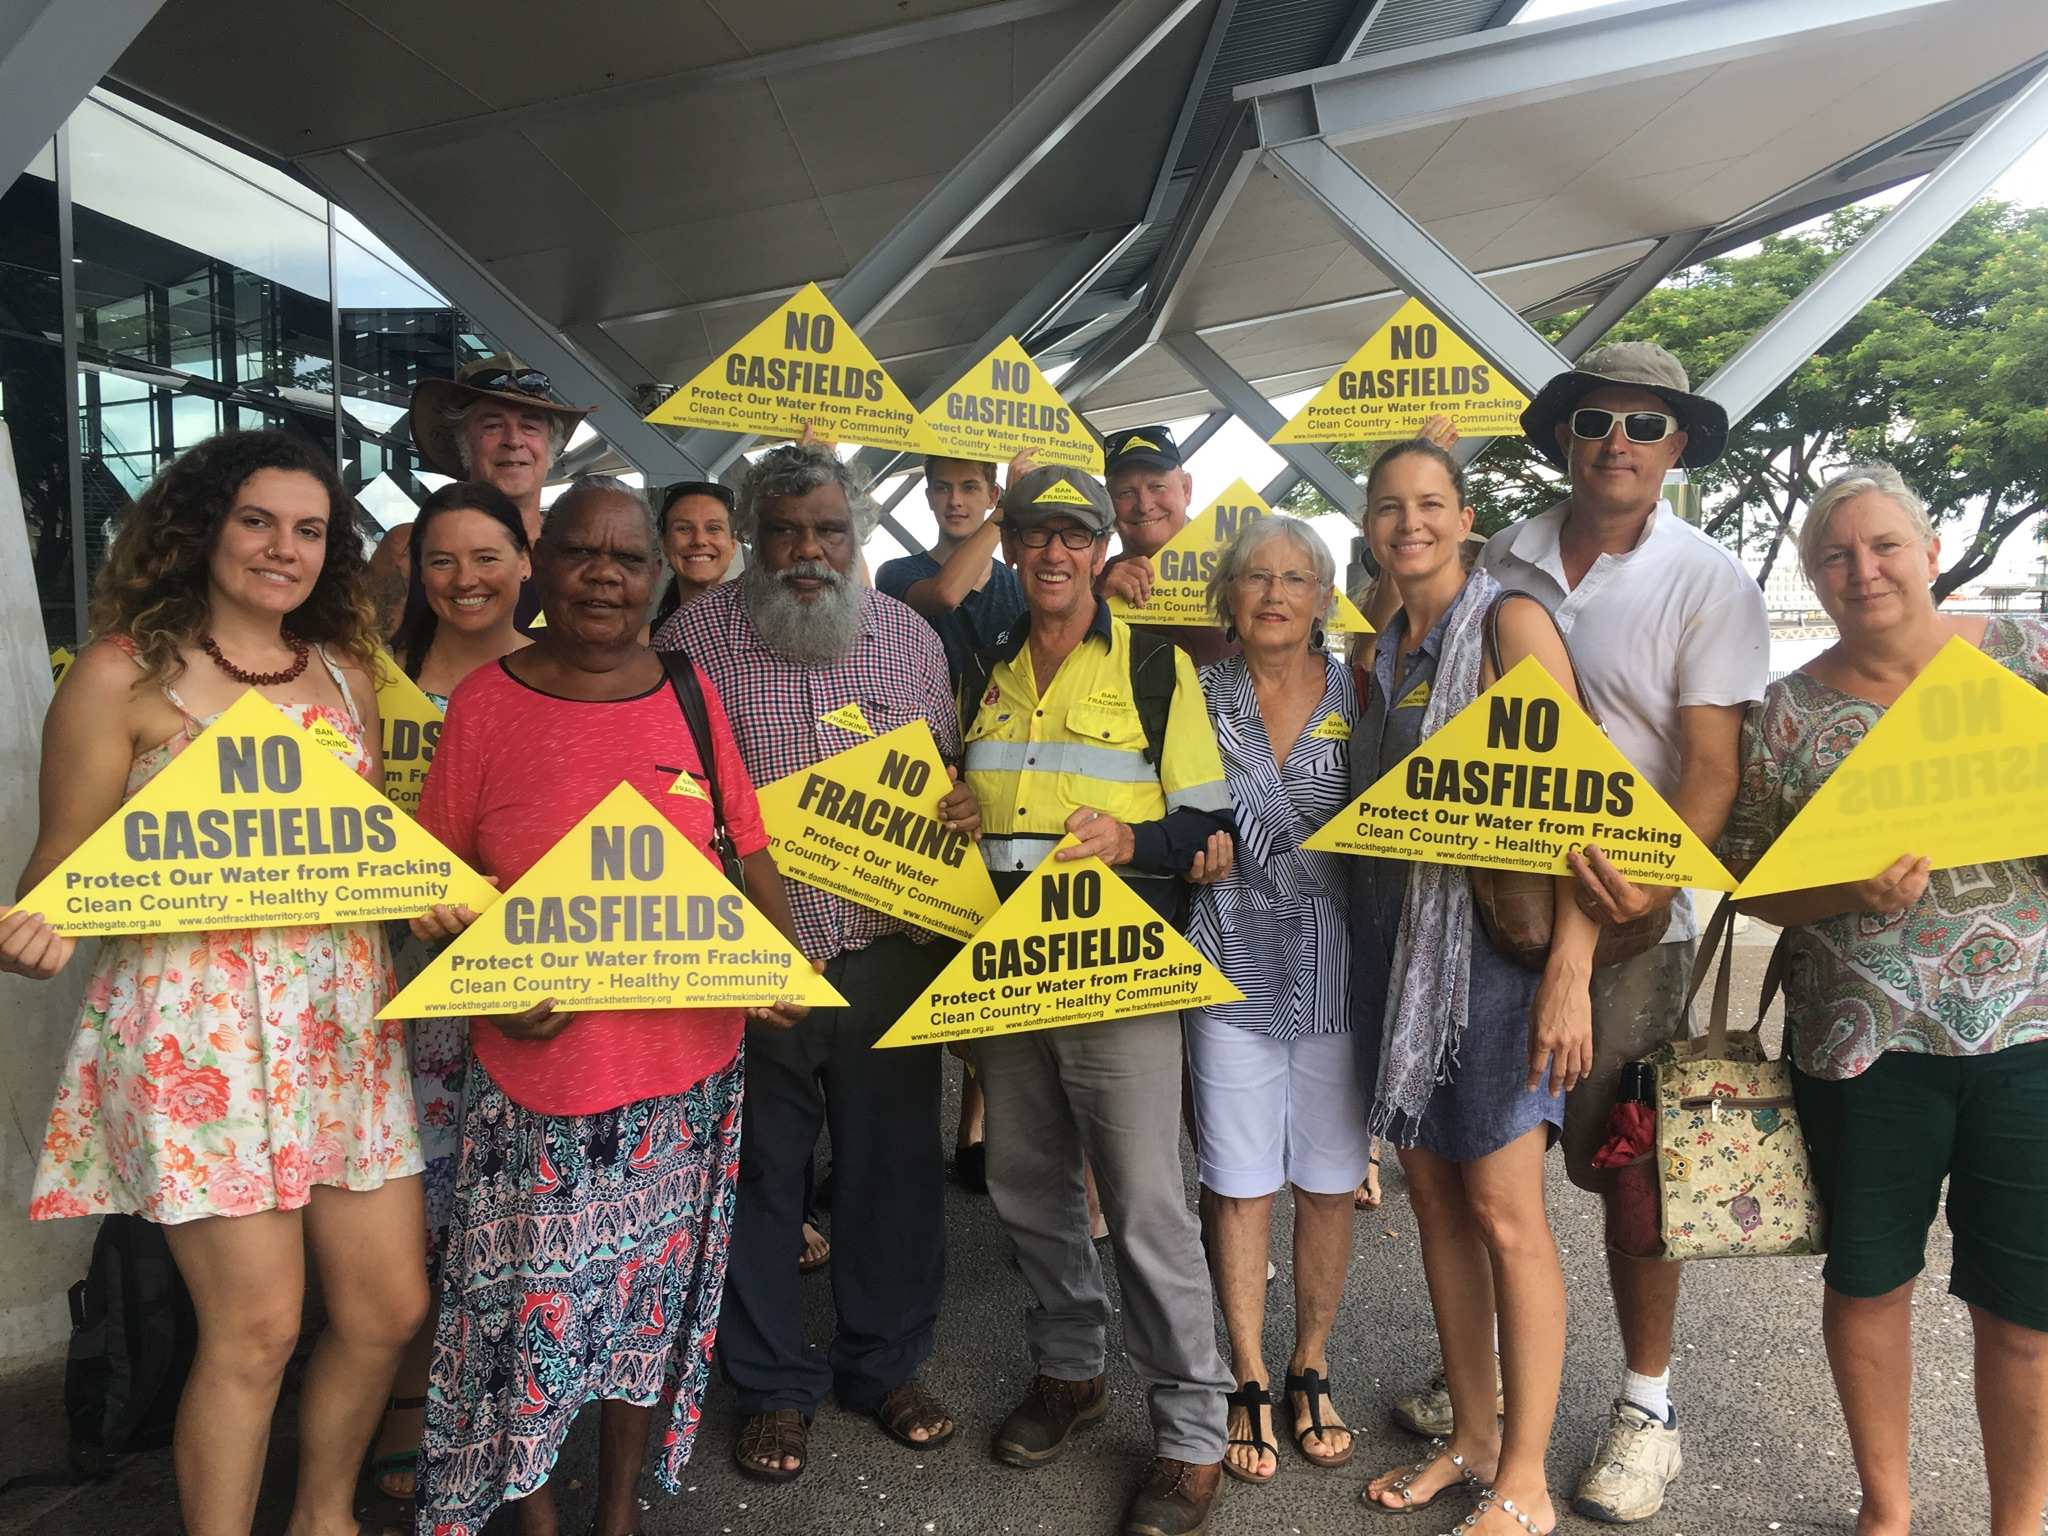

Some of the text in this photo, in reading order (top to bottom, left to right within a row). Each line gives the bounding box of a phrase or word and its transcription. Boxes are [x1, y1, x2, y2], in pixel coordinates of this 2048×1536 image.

[784, 311, 834, 353] NO
[1391, 324, 1437, 360] NO
[726, 353, 884, 402] GASFIELDS
[992, 358, 1030, 394] NO
[1339, 364, 1489, 400] GASFIELDS
[690, 402, 726, 416] Clean
[729, 407, 778, 423] Country
[791, 414, 836, 430] Healthy
[840, 419, 910, 438] Community
[691, 387, 914, 423] Protect Our Water from Fracking
[947, 393, 1070, 434] GASFIELDS
[1308, 398, 1522, 416] Protect Our Water from Fracking
[1308, 420, 1340, 430] Clean
[1344, 418, 1390, 429] Country
[1402, 416, 1431, 426] Healt
[1451, 414, 1520, 424] Community
[925, 420, 1094, 453] otect Our Water from Fracking
[950, 436, 991, 450] Country
[1038, 448, 1092, 464] Community
[1128, 602, 1160, 610] Can
[1151, 586, 1204, 598] tect Our
[1102, 692, 1118, 700] BAN
[315, 728, 333, 736] BAN
[843, 711, 859, 720] BAN
[1487, 696, 1559, 754] NO
[316, 739, 348, 748] CKING
[217, 735, 302, 794] NO
[878, 749, 930, 798] NO
[1406, 756, 1634, 818] GASFIELDS
[124, 805, 396, 862] GASFIELDS
[798, 773, 970, 869] FRACKING
[1360, 802, 1682, 848] Protect Our Water from Fracking
[590, 824, 664, 882] NO
[803, 826, 860, 858] Protect
[864, 850, 891, 868] Our
[896, 860, 939, 887] Water
[1335, 840, 1424, 856] www.lockthegate.org.au
[1436, 850, 1552, 869] www.dontfracktheterritory.org
[1356, 822, 1404, 840] Clean
[1410, 828, 1478, 850] Country
[1496, 836, 1562, 858] Healthy
[66, 860, 451, 889] Protect Our Water from Fracking
[785, 840, 840, 872] Country
[852, 866, 905, 896] Healthy
[908, 886, 984, 925] Community
[67, 897, 132, 914] Clean
[140, 893, 228, 911] Country
[250, 888, 328, 906] Healthy
[335, 882, 448, 901] Community
[1041, 870, 1101, 923] NO
[52, 920, 162, 931] w.lockthegate.org.au
[178, 911, 320, 926] www.dontfracktheterritory.org
[504, 894, 744, 945] GASFIELDS
[451, 950, 792, 971] Protect Our Water from Fracking
[972, 921, 1164, 982] GASFIELDS
[450, 978, 506, 994] Clean
[513, 976, 590, 993] Country
[610, 973, 680, 990] Healthy
[686, 972, 788, 989] Community
[931, 962, 1202, 1008] Protect Our Water from Fracking
[424, 1000, 531, 1012] www.lockthegate.org.au
[556, 995, 672, 1006] w.dontfracktheterritory.org
[930, 1012, 974, 1026] Clean
[980, 1003, 1040, 1020] Country
[1056, 991, 1111, 1010] Healthy
[1116, 980, 1198, 1001] Community
[911, 1026, 994, 1041] www.lockthegate.org.au
[1006, 1010, 1104, 1029] www.dontfracktheterritory.org
